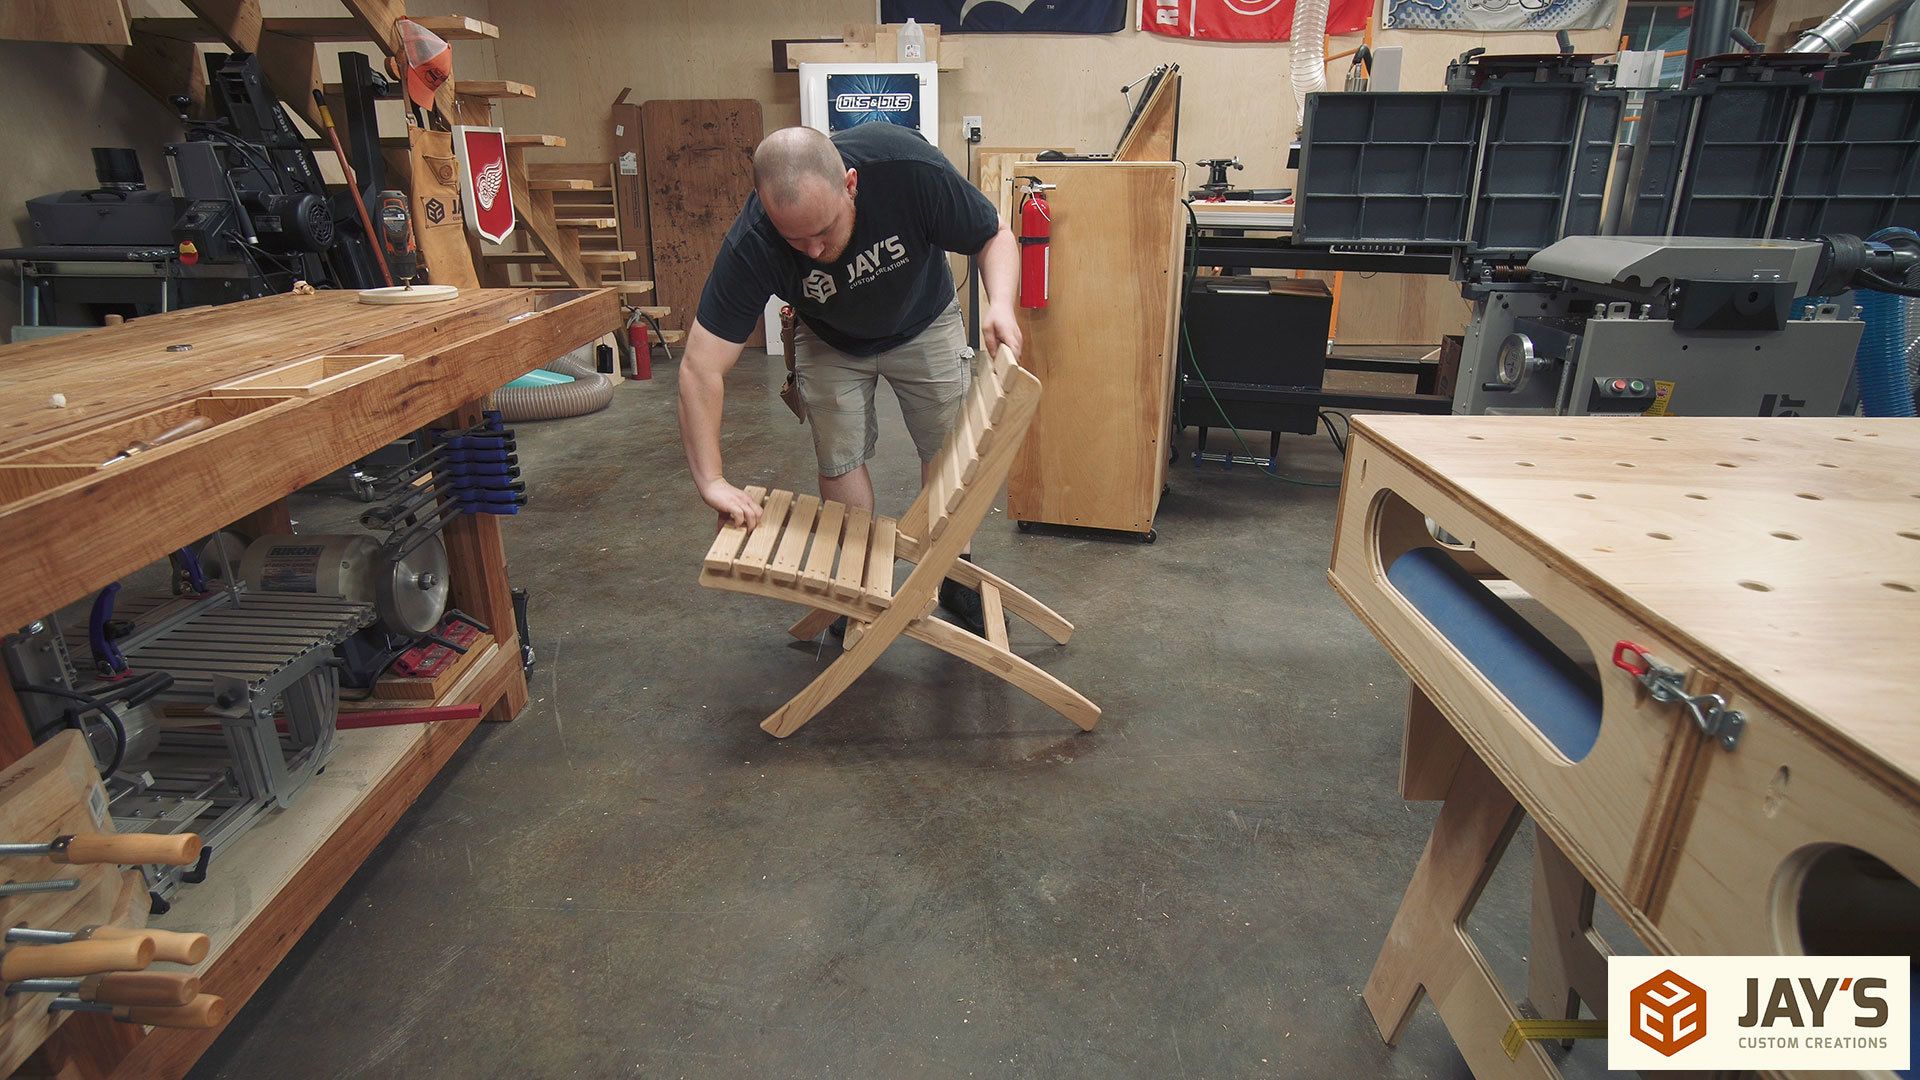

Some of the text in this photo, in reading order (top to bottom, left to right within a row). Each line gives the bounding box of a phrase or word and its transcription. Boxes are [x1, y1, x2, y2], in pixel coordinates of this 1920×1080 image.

[846, 235, 906, 284] JAY'S
[849, 257, 910, 290] CUSTOM CREATIONS
